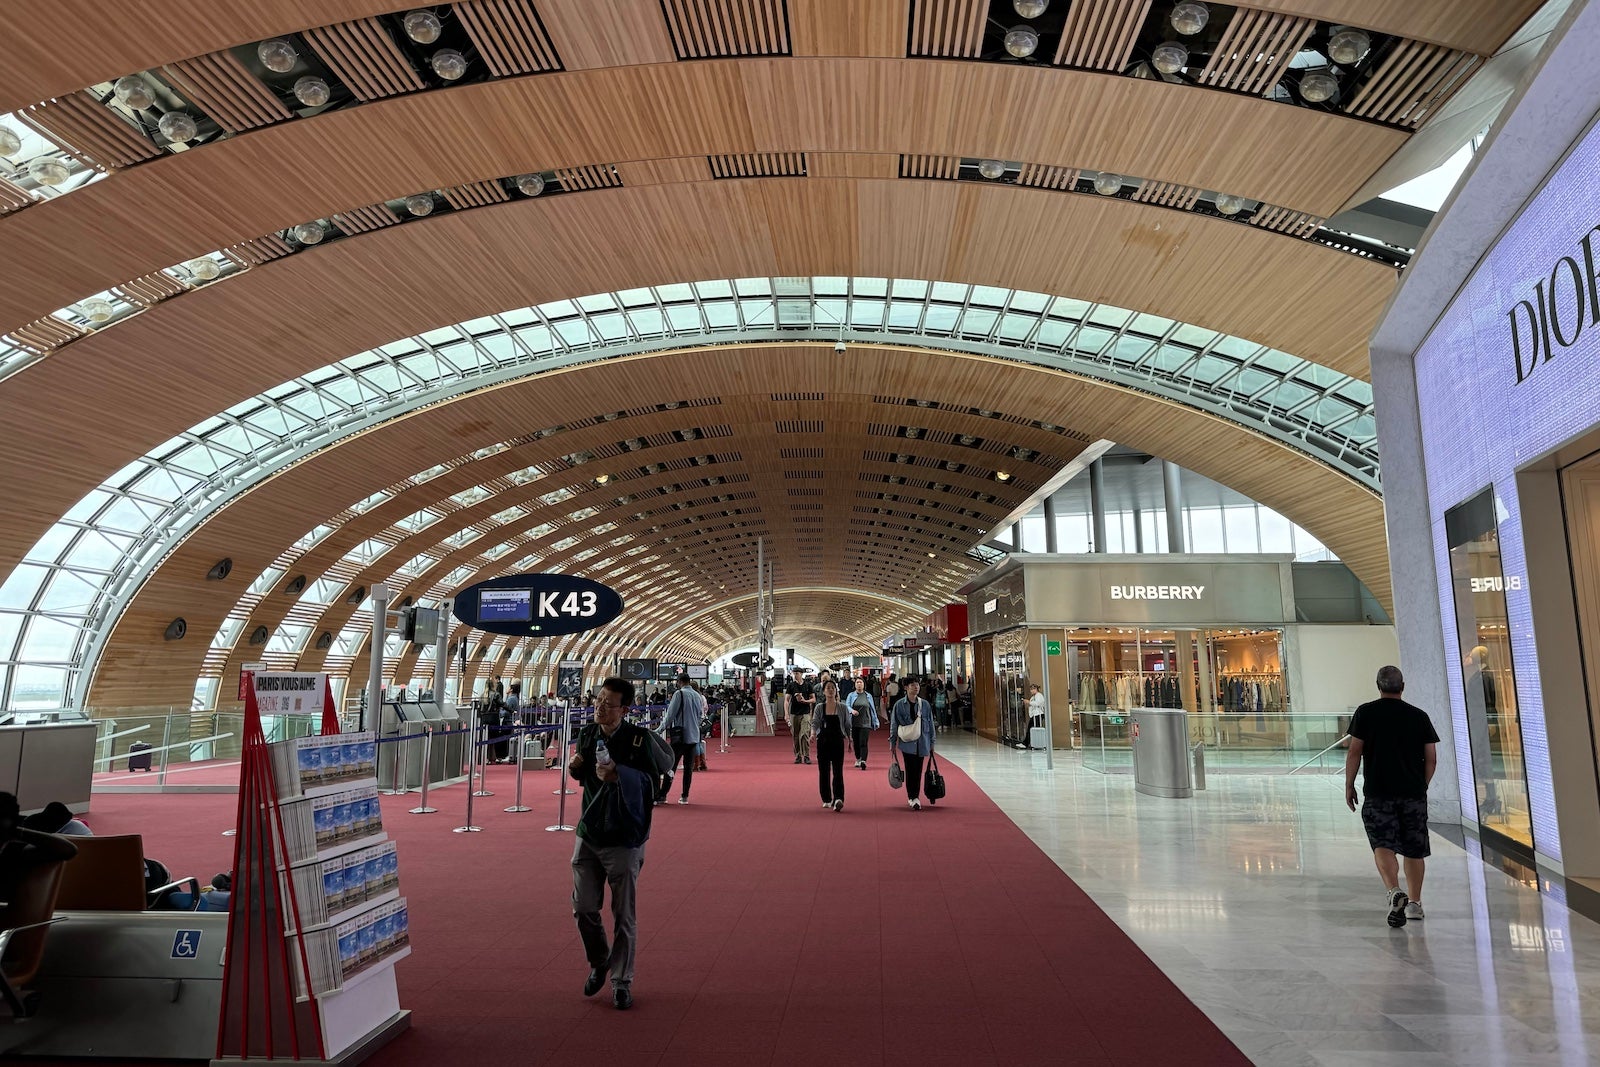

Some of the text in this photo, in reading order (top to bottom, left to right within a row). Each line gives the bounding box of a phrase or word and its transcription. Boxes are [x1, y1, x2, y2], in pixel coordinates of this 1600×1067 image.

[1110, 585, 1205, 600] BURBERRY
[257, 676, 280, 691] PARIS
[280, 677, 299, 691] VOUS
[299, 677, 316, 691] AIME
